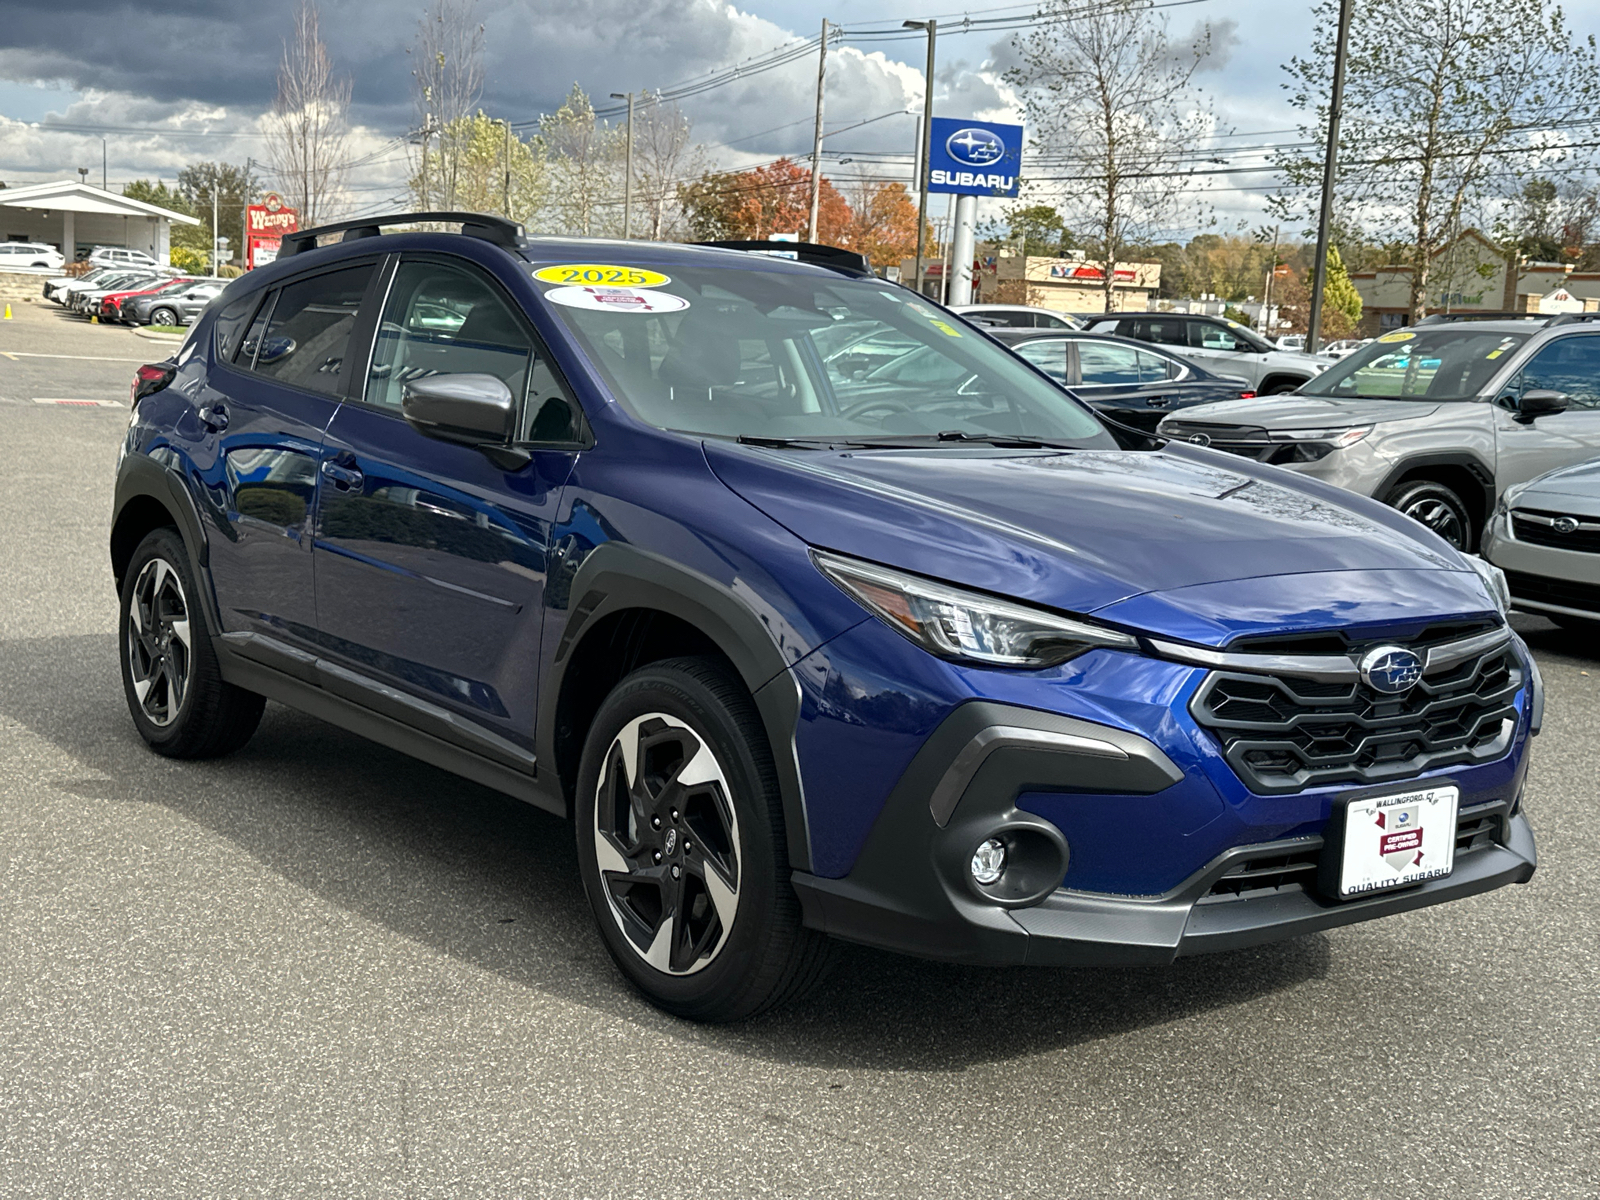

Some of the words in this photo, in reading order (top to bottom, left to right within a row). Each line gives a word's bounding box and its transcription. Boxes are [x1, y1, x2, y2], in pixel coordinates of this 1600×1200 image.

[931, 169, 1013, 190] SUBARU
[561, 269, 647, 284] 2025
[1384, 839, 1419, 851] PRE-OWNED
[1387, 832, 1417, 844] CERTIFIED
[1348, 877, 1399, 894] QUALITY
